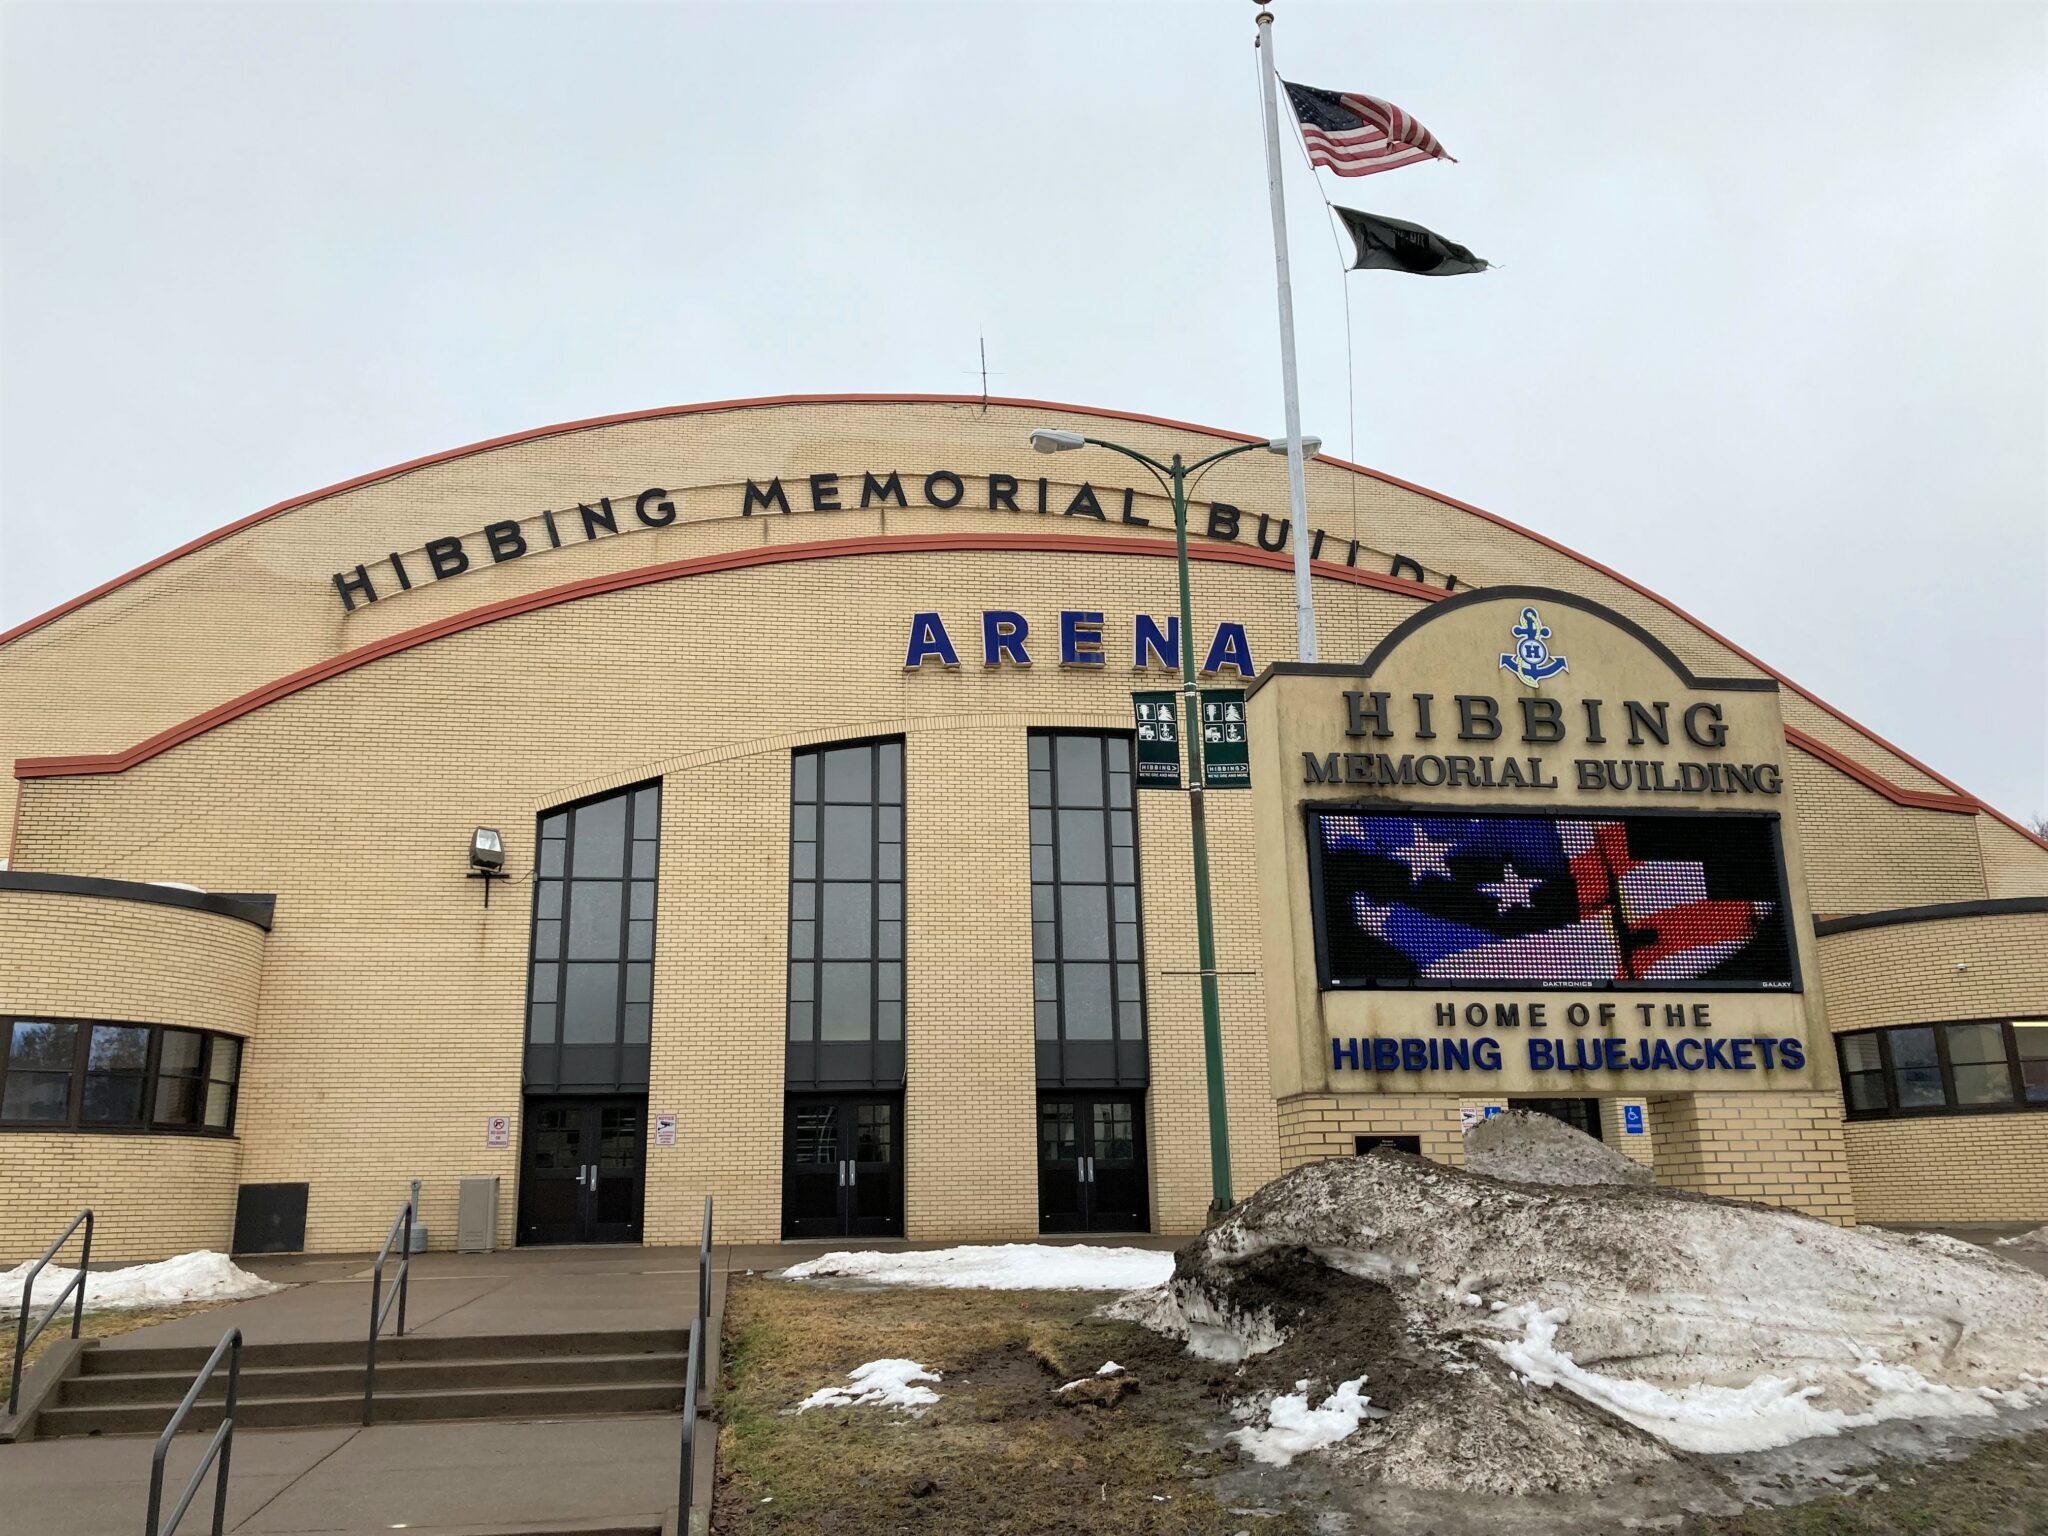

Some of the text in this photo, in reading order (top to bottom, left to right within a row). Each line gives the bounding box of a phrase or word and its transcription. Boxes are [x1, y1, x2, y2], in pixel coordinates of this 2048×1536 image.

[332, 487, 677, 611] HIBBING
[743, 469, 1150, 527] MEMORIAL
[903, 610, 1256, 679] ARENA
[1525, 645, 1541, 659] H
[1342, 690, 1729, 748] HIBBING
[1302, 751, 1783, 794] MEMORIAL BUILDING
[1435, 1002, 1712, 1027] HOME OF THE
[1332, 1037, 1806, 1071] HIBBING BLUEJACKETS
